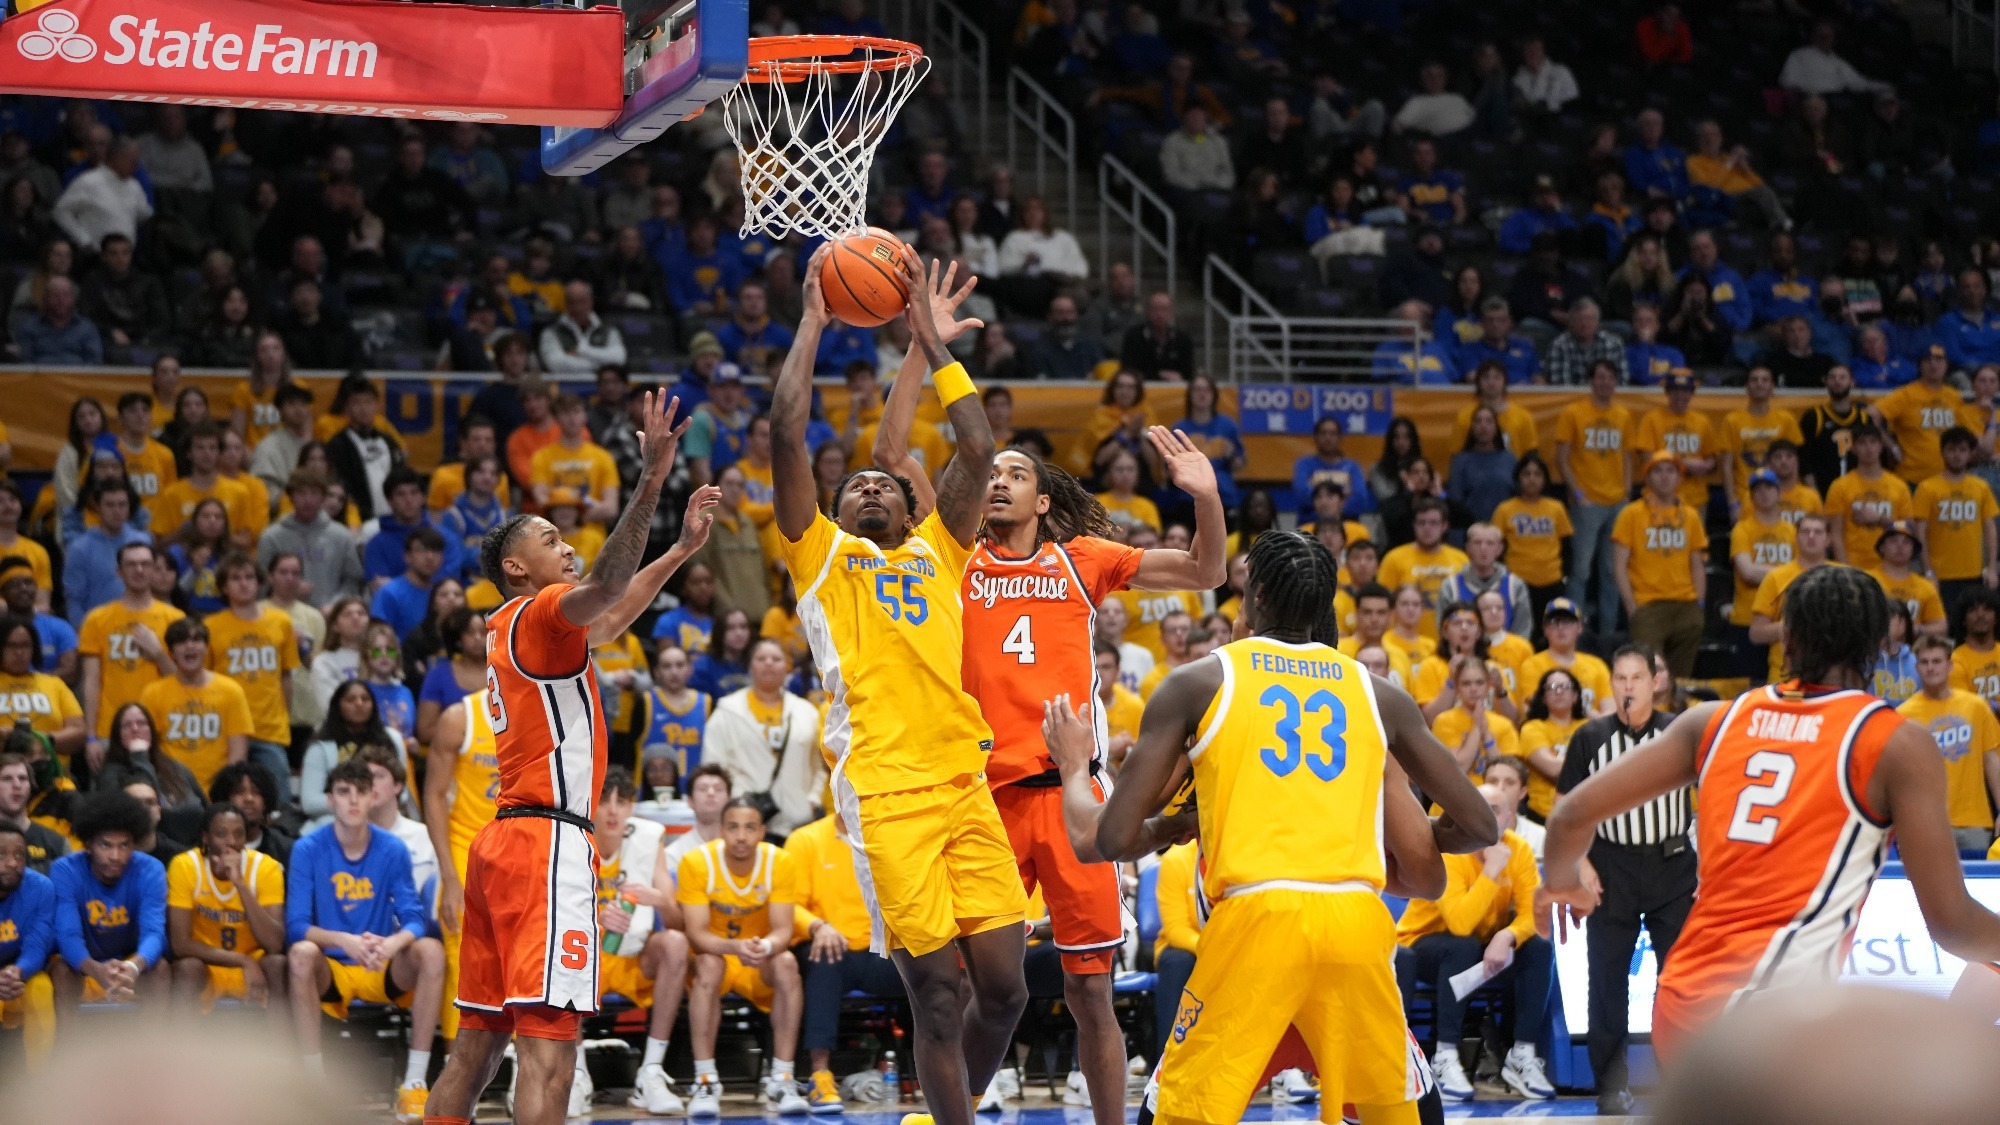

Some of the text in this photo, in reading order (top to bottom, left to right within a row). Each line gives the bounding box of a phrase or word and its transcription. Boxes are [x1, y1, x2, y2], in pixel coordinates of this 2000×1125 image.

[103, 14, 378, 78] State Farm
[1243, 389, 1290, 410] ZOO
[1323, 391, 1369, 412] ZOO
[1920, 406, 1956, 429] ZOO
[1584, 427, 1622, 449] ZOO
[1664, 433, 1701, 454] ZOO
[1512, 512, 1555, 536] Pitt
[1937, 500, 1977, 522] ZOO
[1645, 526, 1687, 550] ZOO
[1753, 542, 1793, 565] ZOO
[875, 573, 929, 627] 55
[969, 570, 1069, 609] Syracuse
[1001, 614, 1036, 665] 4
[227, 644, 278, 674] ZOO
[1251, 652, 1344, 681] FEDERIKO
[167, 713, 221, 739] ZOO
[1259, 684, 1347, 783] 33
[1746, 708, 1825, 743] STARLING
[1726, 749, 1797, 845] 2
[331, 871, 376, 900] Pitt
[86, 899, 130, 928] Pitt
[220, 926, 237, 951] 8
[560, 929, 589, 971] S
